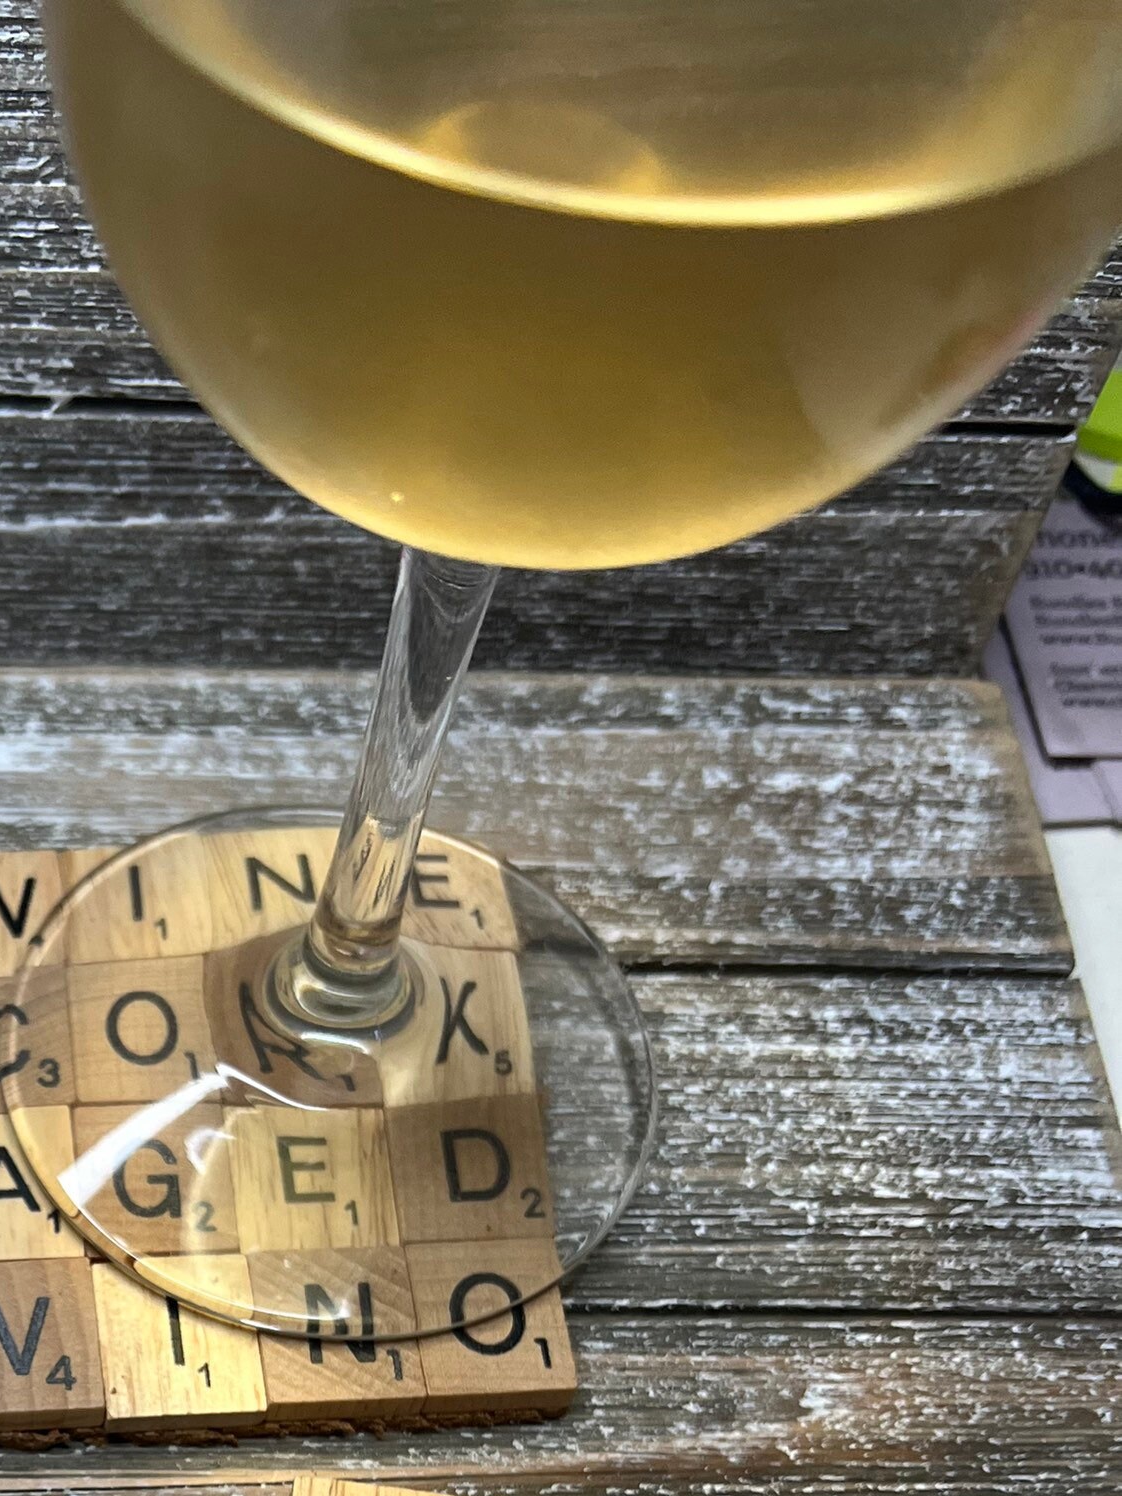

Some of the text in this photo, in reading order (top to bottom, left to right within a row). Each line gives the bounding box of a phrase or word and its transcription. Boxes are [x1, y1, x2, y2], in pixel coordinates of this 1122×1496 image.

[154, 907, 484, 941] 1 1
[37, 1058, 61, 1087] 3
[184, 1051, 198, 1080] 1
[494, 1051, 513, 1075] 5
[47, 1187, 546, 1234] 1 2 1 2
[45, 1338, 552, 1391] 4 1 1 1
